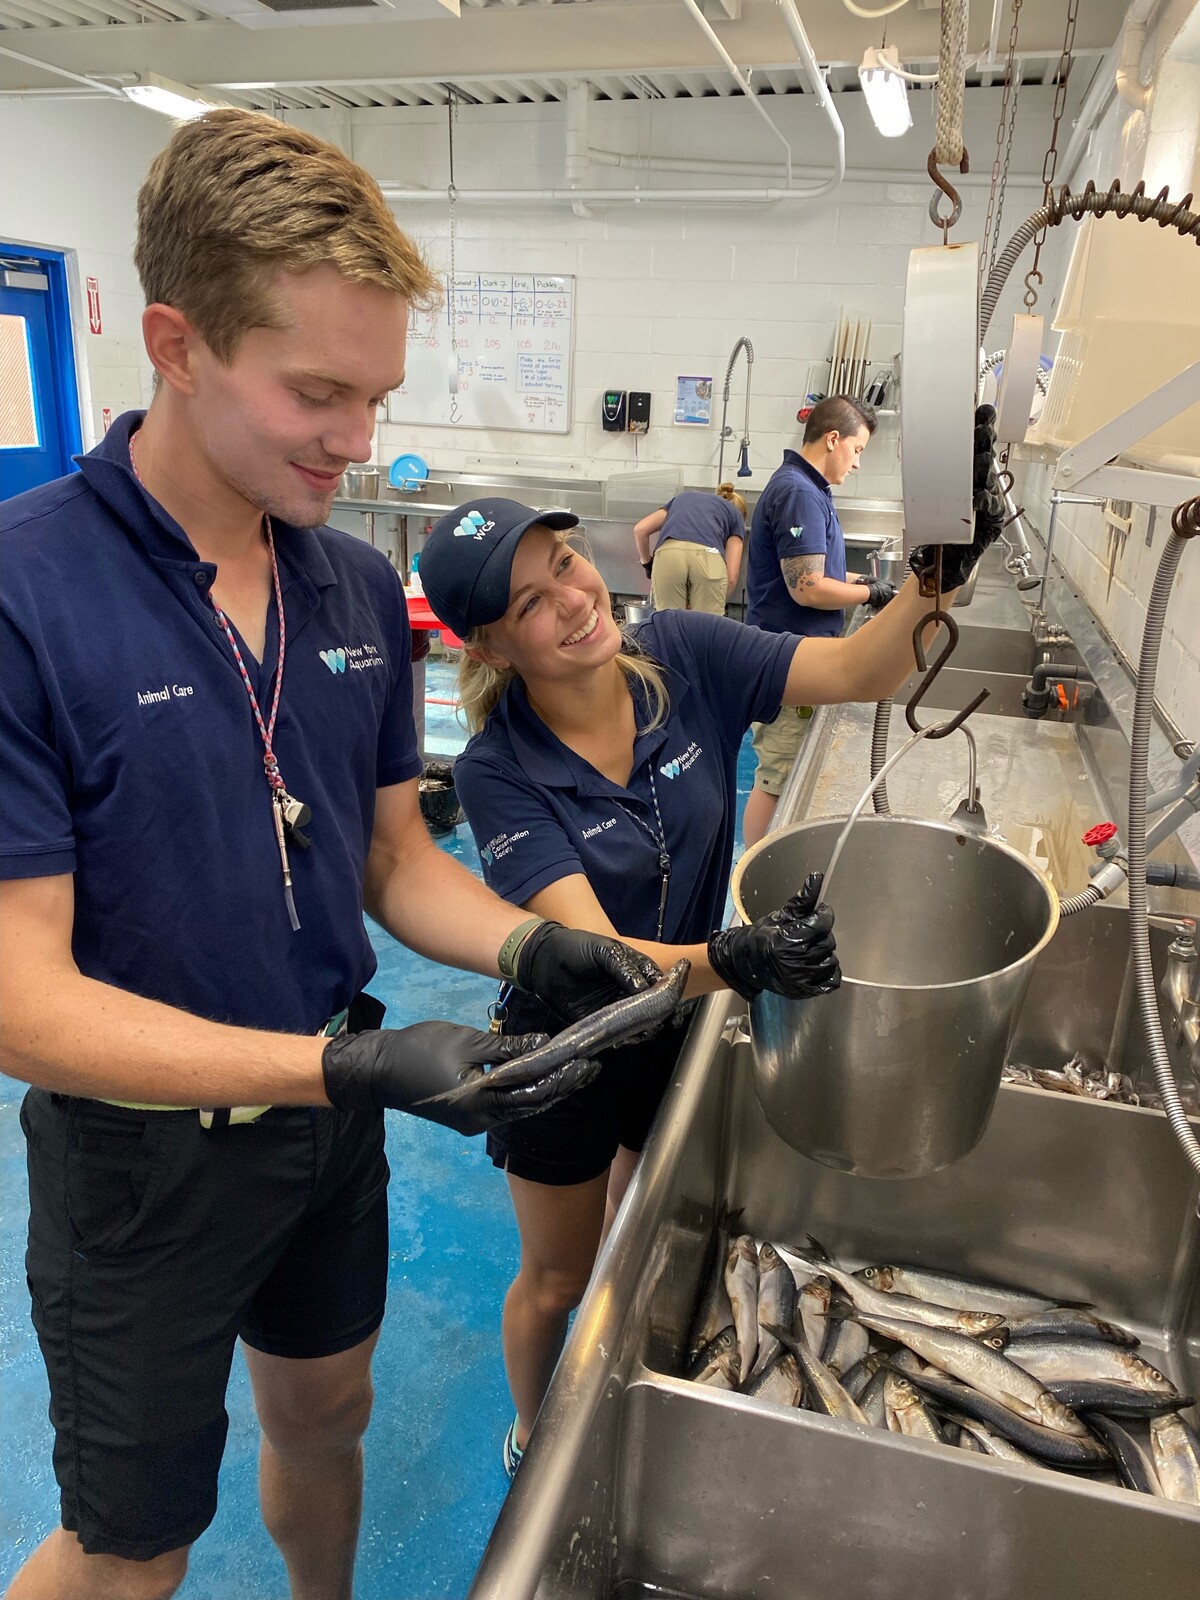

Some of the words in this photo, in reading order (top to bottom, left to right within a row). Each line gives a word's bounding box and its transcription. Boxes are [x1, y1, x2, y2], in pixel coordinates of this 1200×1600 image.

[484, 339, 501, 349] 205
[473, 520, 496, 540] WCS
[344, 646, 363, 657] New
[362, 643, 378, 654] York
[349, 655, 384, 672] Aquarium
[137, 685, 170, 706] Animal
[172, 684, 194, 697] Care
[677, 751, 690, 765] New
[687, 741, 698, 754] York
[682, 747, 703, 772] Aquarium
[581, 823, 603, 840] Animal
[601, 818, 617, 830] Care
[491, 830, 530, 854] Conservation
[494, 845, 513, 860] Society
